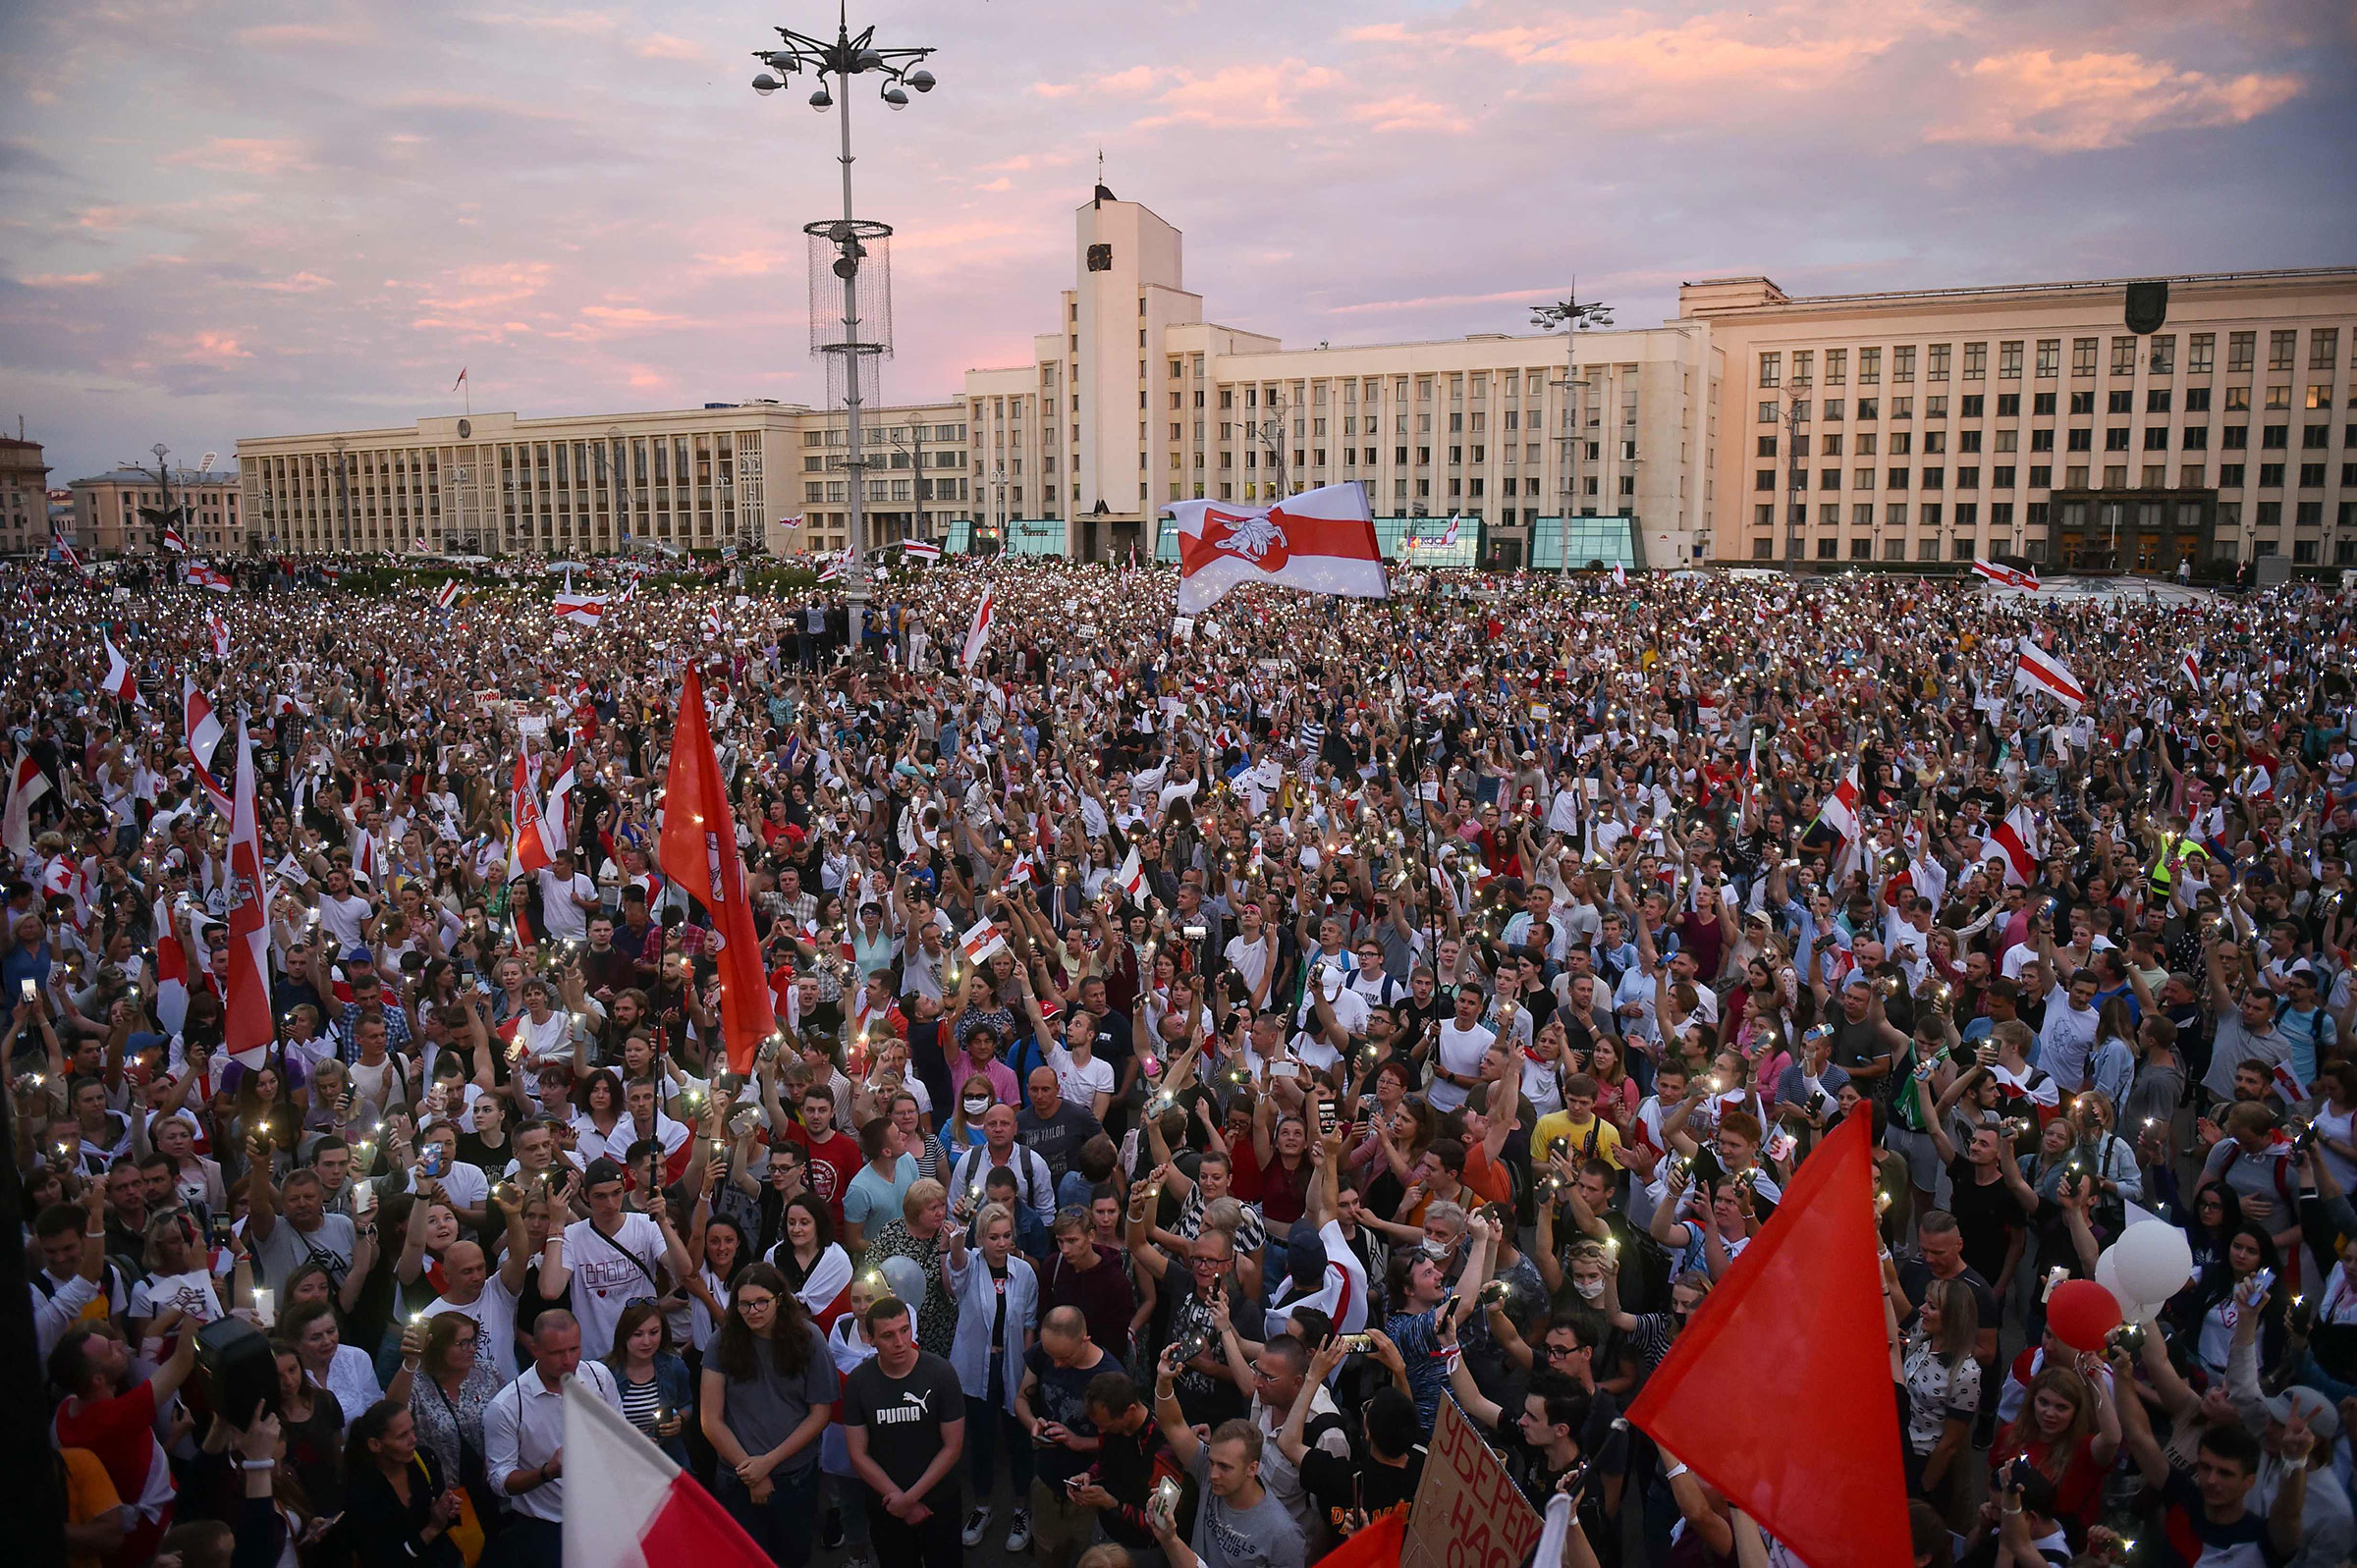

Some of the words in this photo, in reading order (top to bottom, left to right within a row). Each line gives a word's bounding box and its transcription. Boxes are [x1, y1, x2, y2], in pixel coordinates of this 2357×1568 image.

[1041, 1124, 1066, 1142] TAILOR
[876, 1406, 920, 1425] PUMA
[1218, 1537, 1240, 1557] CLUB
[1227, 1533, 1256, 1554] HILLS
